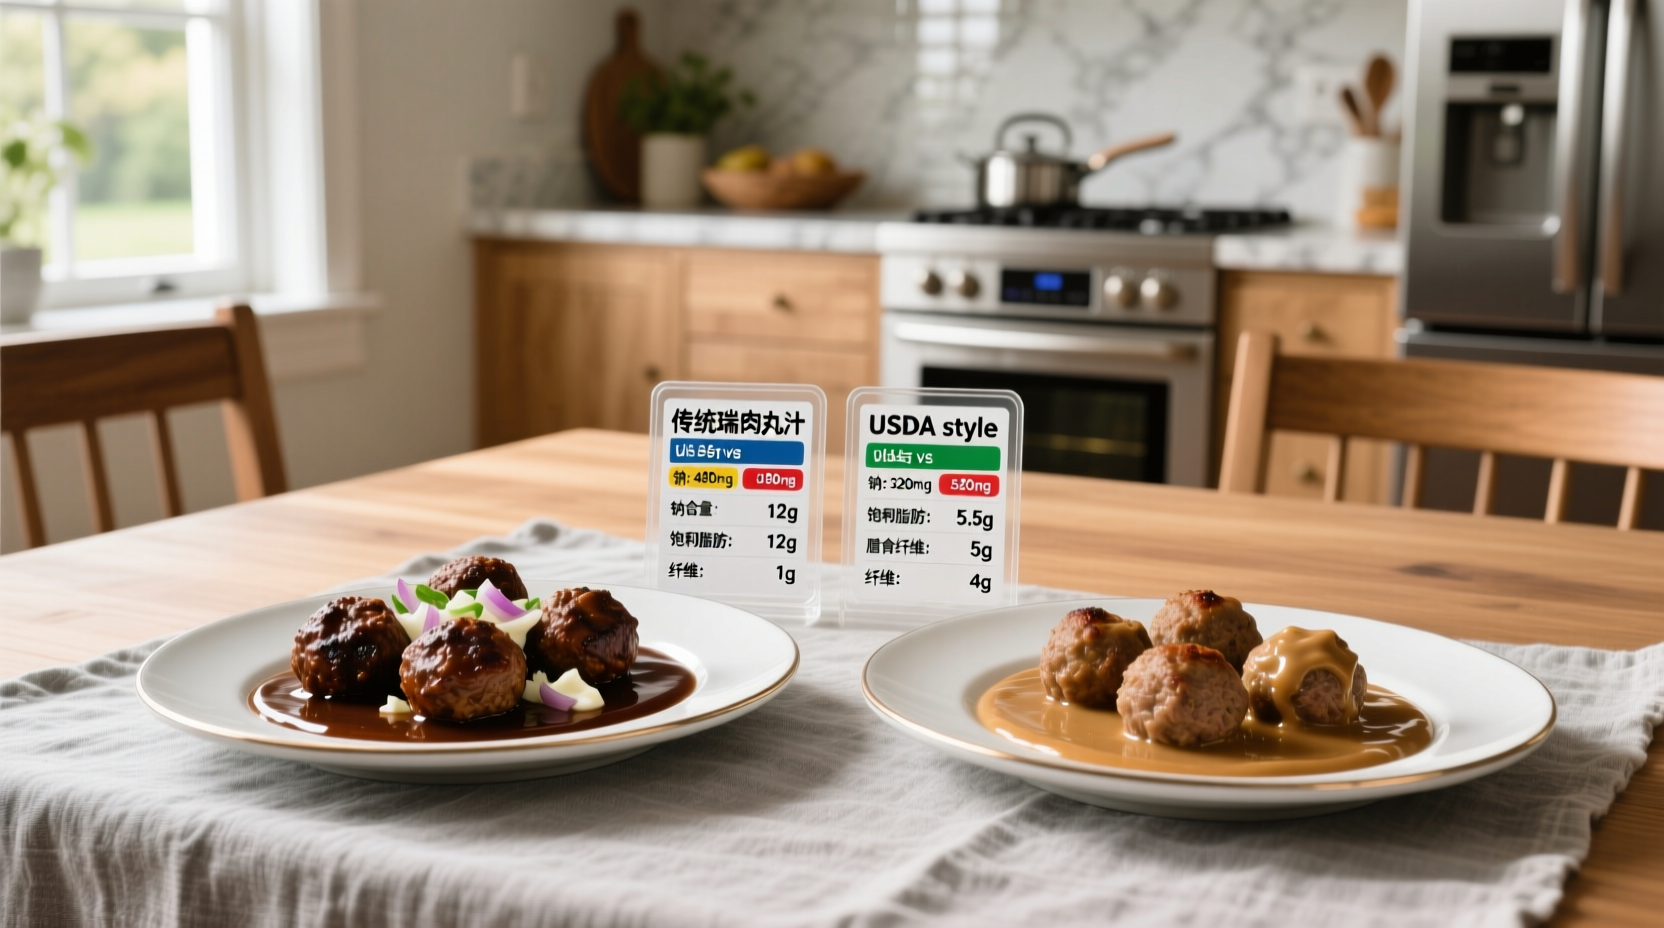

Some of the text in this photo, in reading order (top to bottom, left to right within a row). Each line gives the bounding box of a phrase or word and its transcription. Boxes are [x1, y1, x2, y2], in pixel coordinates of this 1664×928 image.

[671, 408, 805, 435] 传统瑞肉丸汁
[870, 414, 998, 443] USDA style
[767, 503, 798, 524] 12g
[956, 508, 994, 532] 5.5g
[767, 533, 797, 554] 12g
[970, 540, 993, 562] 5g
[776, 565, 796, 585] 1g
[969, 573, 992, 594] 4g
